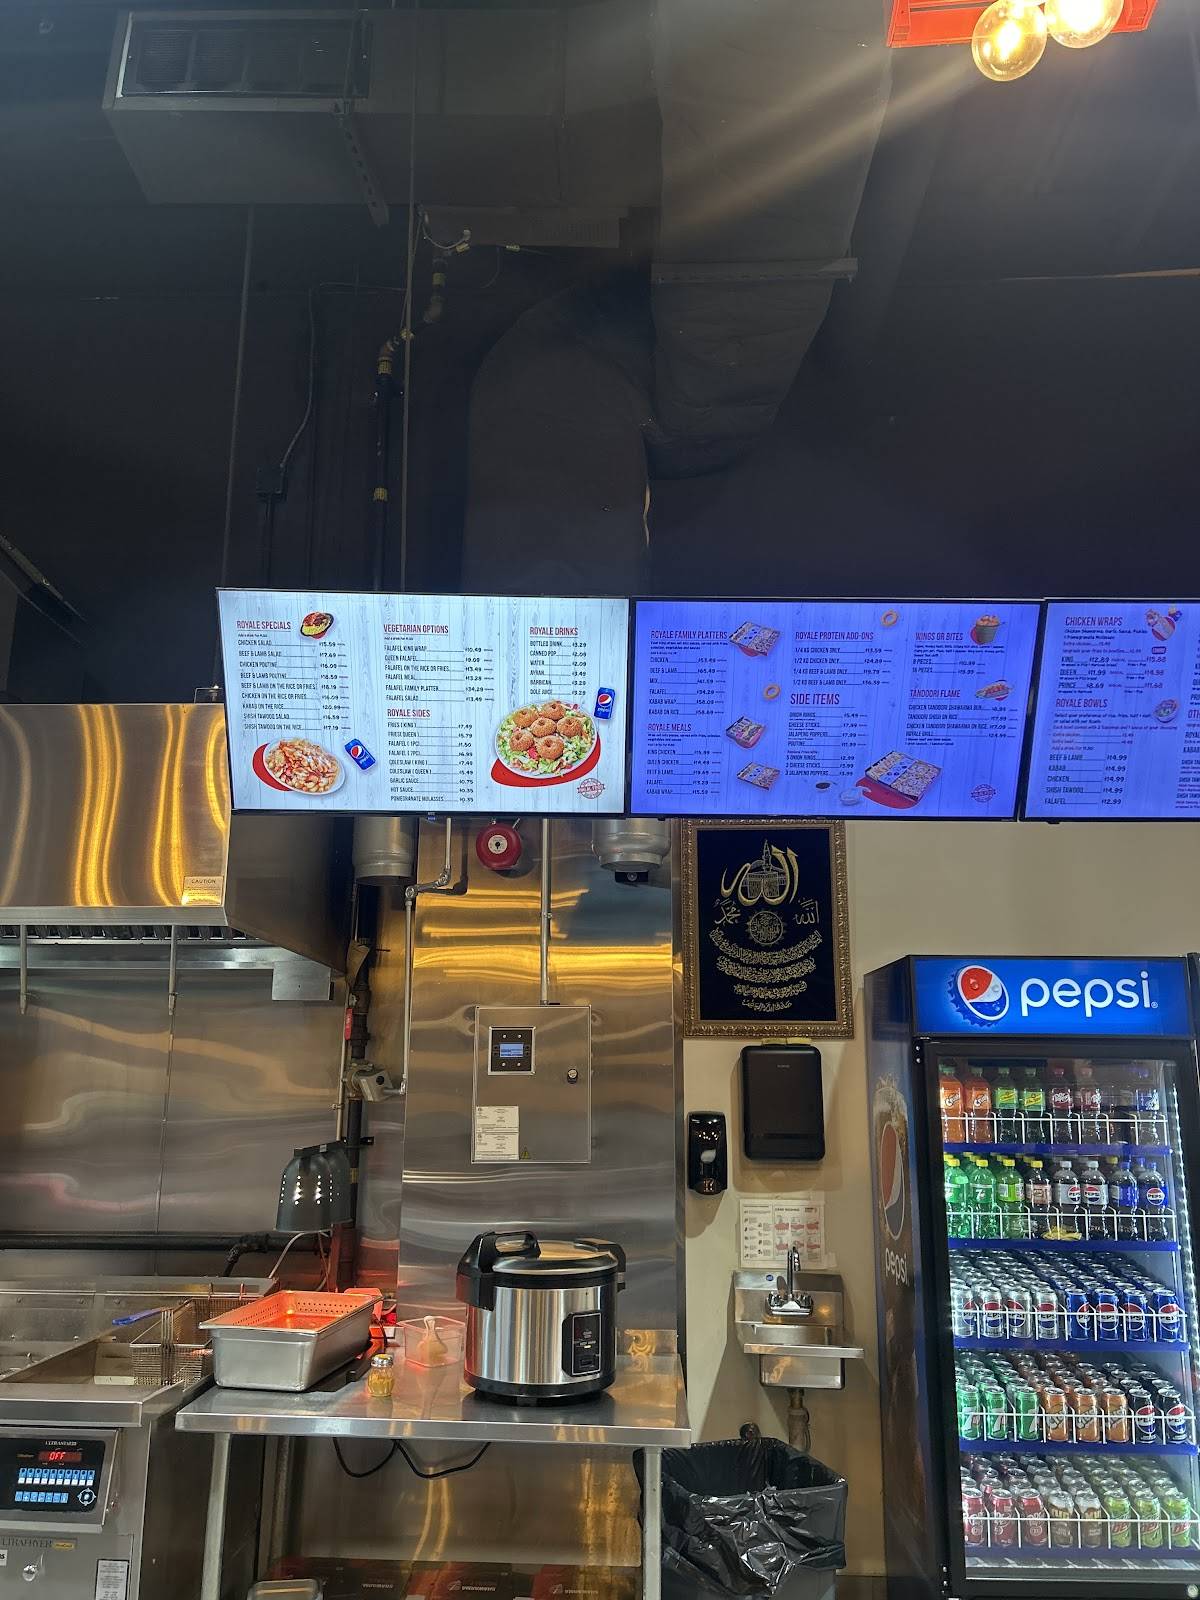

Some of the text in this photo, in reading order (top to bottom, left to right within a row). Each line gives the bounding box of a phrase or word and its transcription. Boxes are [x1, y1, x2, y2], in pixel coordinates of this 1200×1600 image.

[237, 621, 291, 630] ROYALE SPECIALS
[1065, 616, 1122, 626] CHICKEN WRAPS
[384, 624, 449, 634] VEGETARIAN OPTIONS
[530, 626, 578, 636] ROYALE DRINKS
[650, 630, 728, 640] ROYALE FAMILY PLATTERS
[795, 632, 874, 640] ROYALE PROTEIN ADD-ONS
[915, 632, 964, 641] WINGS OR BITES
[790, 693, 840, 705] SIDE ITEMS
[910, 690, 961, 698] TANDOORI FLAME
[1056, 698, 1108, 708] ROYALE BOWLS
[387, 708, 431, 718] ROYALE SIDES
[648, 723, 692, 732] ROYALE MEALS
[1020, 971, 1151, 1017] pepsi
[885, 1247, 908, 1285] pepsi
[49, 1452, 66, 1461] OFF
